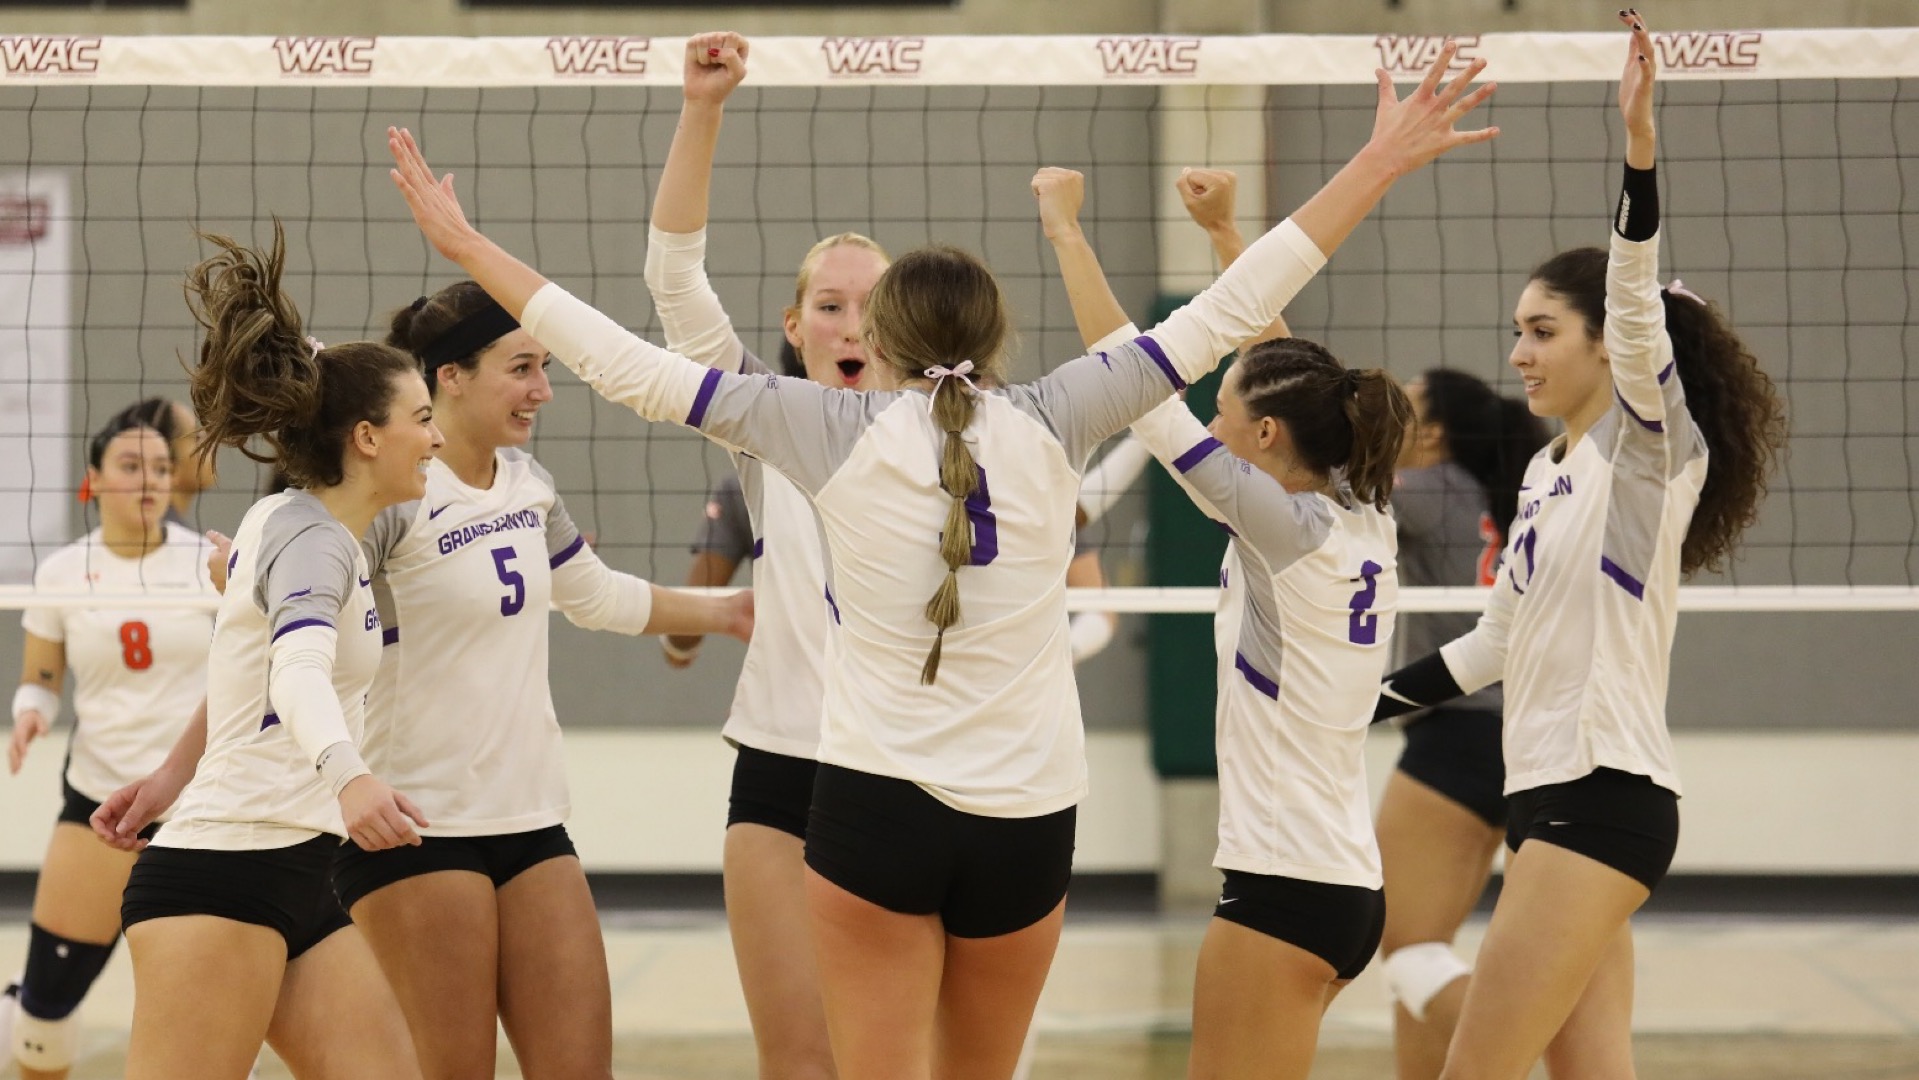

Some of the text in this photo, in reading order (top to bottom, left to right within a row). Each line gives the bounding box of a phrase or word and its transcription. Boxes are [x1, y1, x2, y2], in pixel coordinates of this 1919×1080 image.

[0, 37, 101, 73] WAC
[273, 37, 375, 73] WAC
[547, 37, 649, 73] WAC
[821, 38, 924, 73] WAC
[1096, 38, 1201, 73] WAC
[1376, 33, 1480, 70] WAC
[1656, 32, 1761, 67] WAC
[491, 546, 525, 616] 5
[1349, 559, 1383, 644] 2
[119, 620, 153, 672] 8
